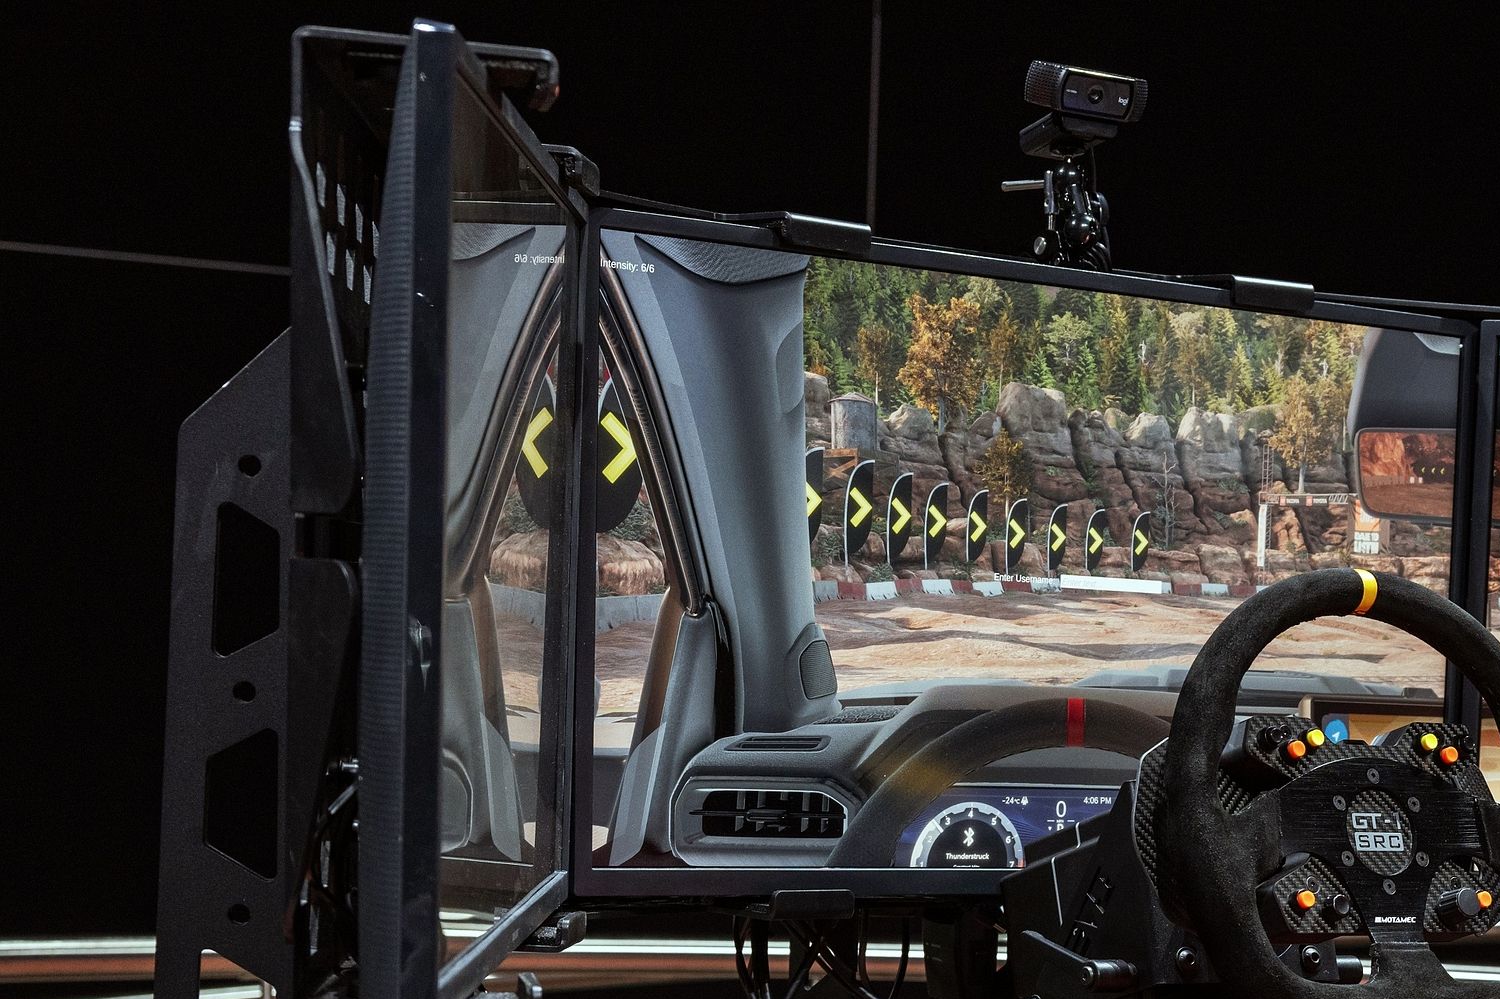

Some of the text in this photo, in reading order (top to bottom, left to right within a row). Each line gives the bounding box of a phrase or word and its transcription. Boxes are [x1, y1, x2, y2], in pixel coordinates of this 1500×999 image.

[1117, 96, 1129, 106] logi
[600, 258, 655, 273] Intensity: 6/6
[993, 572, 1014, 583] Enter
[1100, 796, 1112, 805] PM
[1055, 800, 1067, 818] 0
[945, 817, 951, 825] 3
[991, 817, 997, 826] 5
[1005, 835, 1012, 844] 6
[1358, 834, 1401, 849] SRC
[1381, 916, 1417, 924] MOTAMEC
